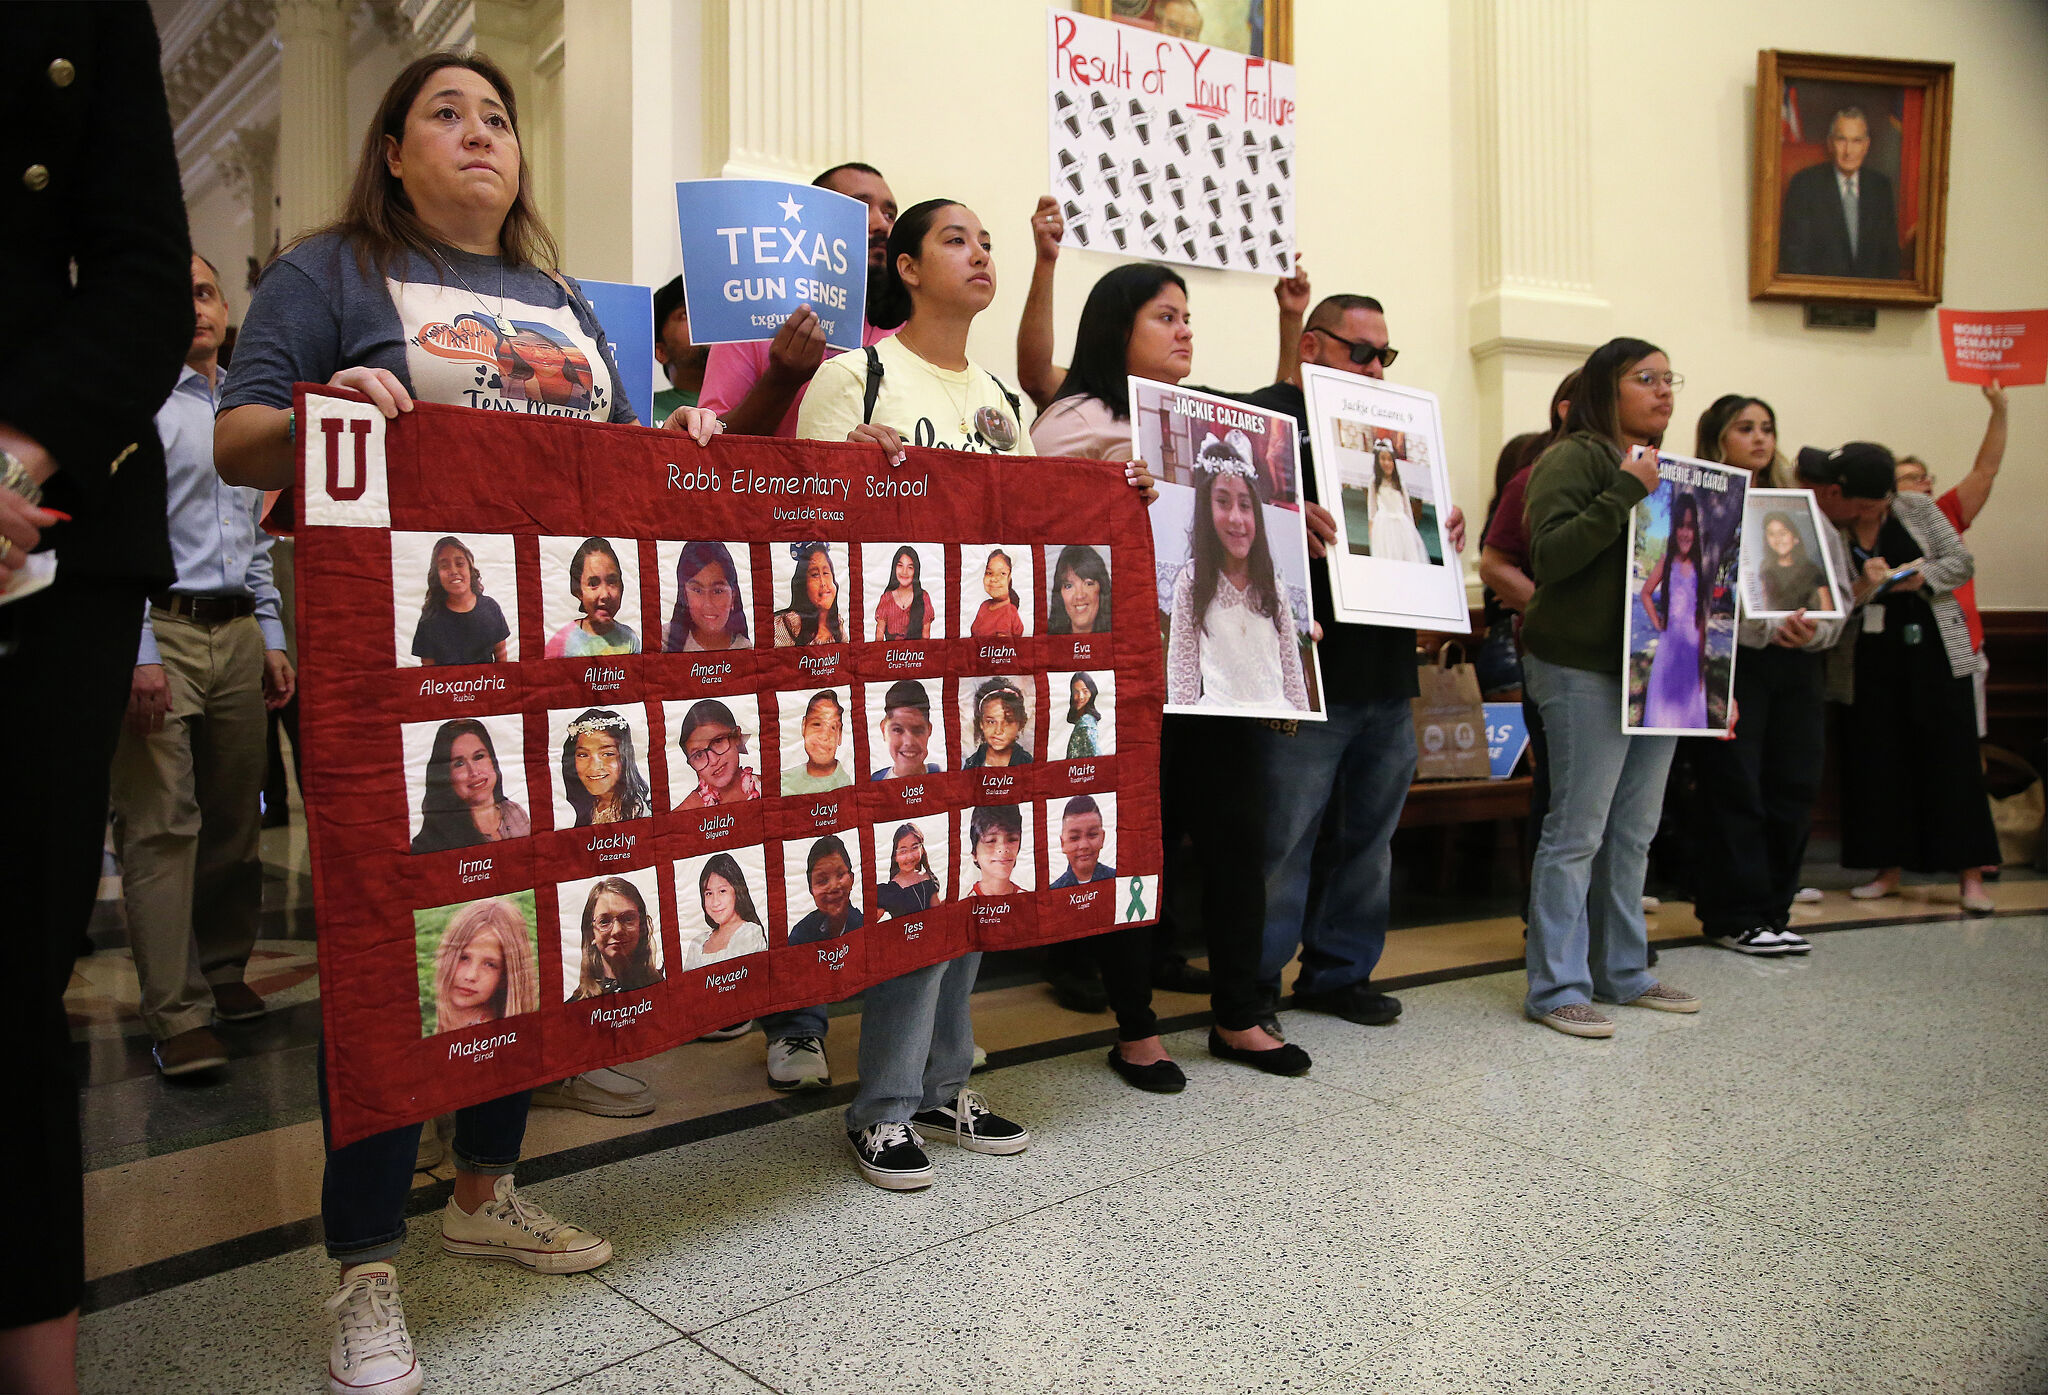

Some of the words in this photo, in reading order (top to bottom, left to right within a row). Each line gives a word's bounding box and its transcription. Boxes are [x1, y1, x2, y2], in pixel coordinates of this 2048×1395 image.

[1055, 14, 1132, 90] Result
[1143, 42, 1172, 95] of
[1180, 43, 1236, 114] Your
[1245, 57, 1295, 126] Failure
[716, 226, 848, 275] TEXAS
[723, 277, 787, 302] GUN
[794, 277, 848, 311] SENSE
[1173, 395, 1216, 423] JACKIE
[1216, 405, 1266, 435] CAZARES
[321, 418, 371, 501] U
[666, 462, 722, 492] Robb
[731, 469, 851, 502] Elementary
[865, 473, 929, 498] School
[886, 649, 925, 662] Eliahna
[979, 645, 1017, 659] Eliahn
[1073, 641, 1091, 654] Eva
[584, 666, 626, 683] Alithia
[690, 660, 732, 677] Amerie
[419, 674, 507, 696] Alexandria
[701, 675, 722, 685] Garza
[452, 692, 476, 703] Rubio
[1068, 763, 1096, 777] Maite
[982, 774, 1014, 788] Layla
[901, 783, 925, 799] José
[699, 815, 735, 833] Jailah
[587, 832, 636, 852] Jacklyn
[599, 851, 631, 862] Cazares
[458, 855, 493, 876] Irma
[462, 871, 491, 884] Garcia
[1069, 890, 1099, 906] Xavier
[971, 902, 1010, 917] Uziyah
[903, 921, 924, 934] Tess
[705, 966, 748, 989] Nevaeh
[718, 983, 736, 993] Bravo
[590, 998, 653, 1025] Maranda
[610, 1016, 636, 1028] Mathis
[448, 1031, 517, 1060] Makenna
[473, 1050, 495, 1063] Elrod
